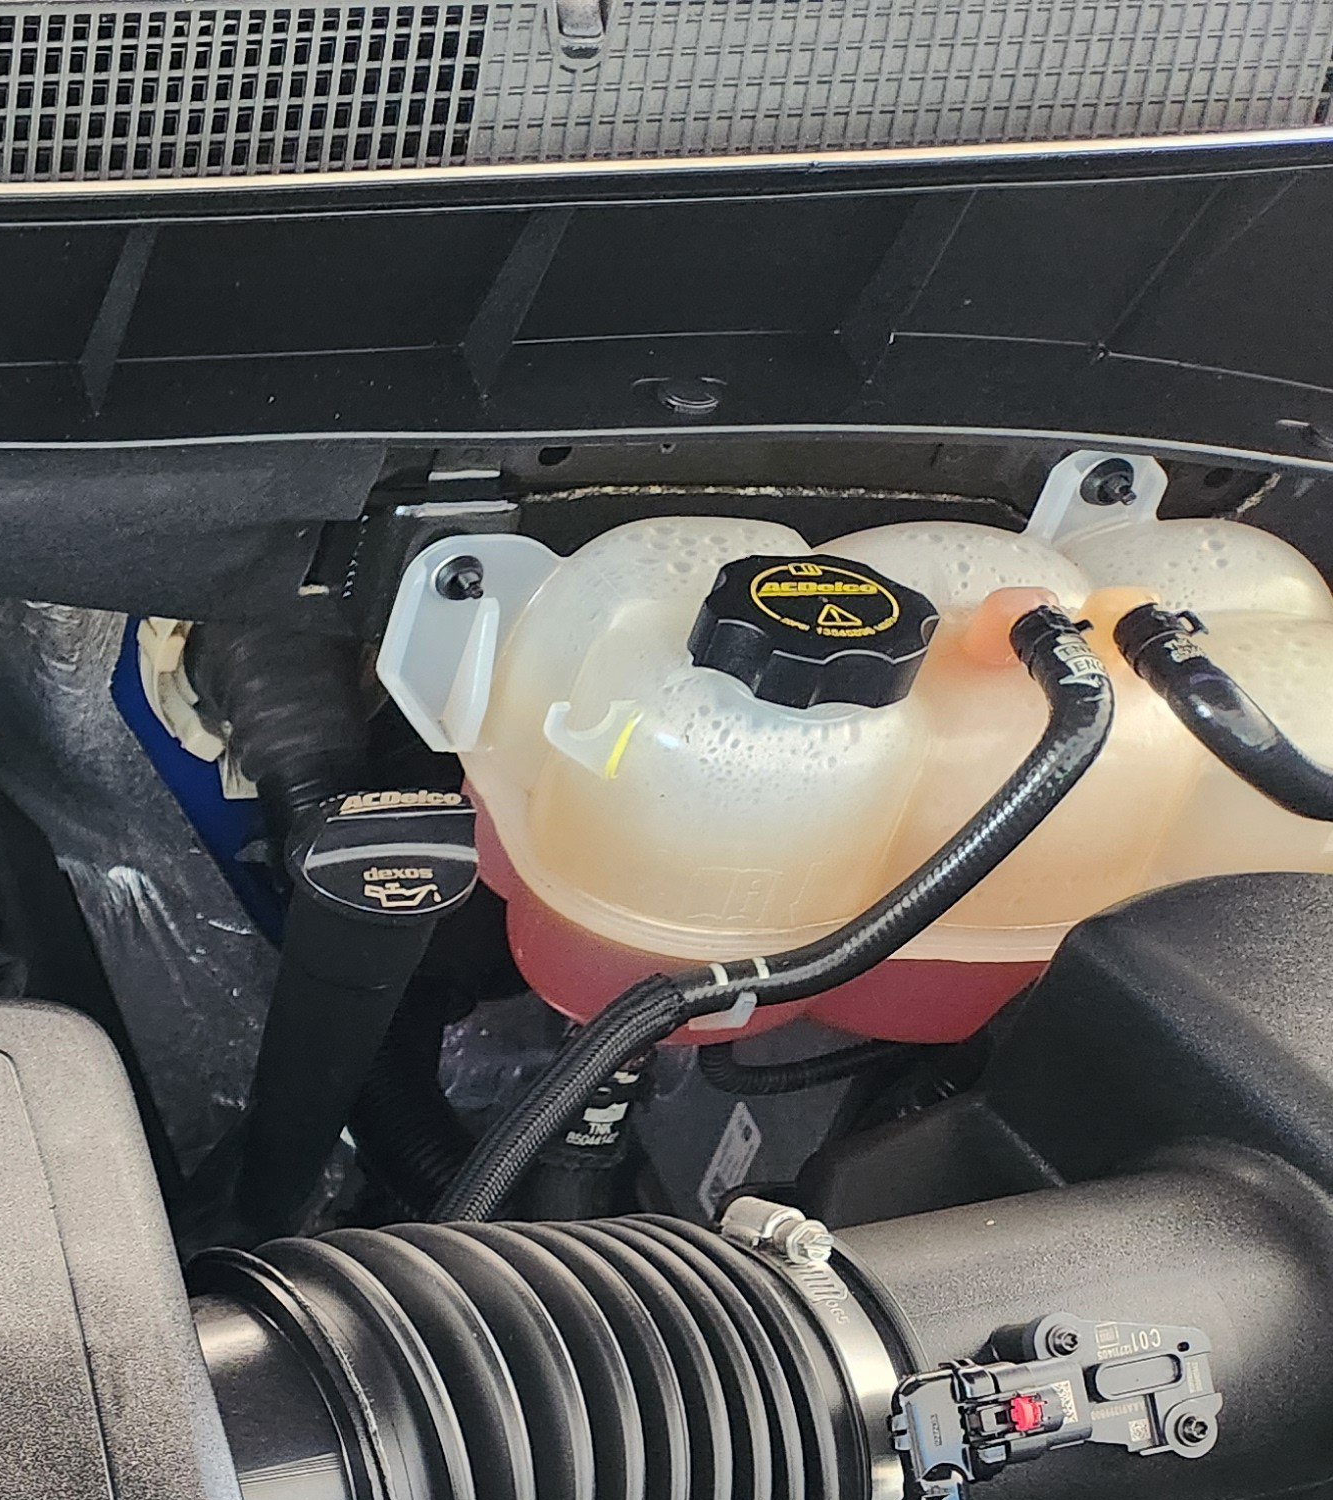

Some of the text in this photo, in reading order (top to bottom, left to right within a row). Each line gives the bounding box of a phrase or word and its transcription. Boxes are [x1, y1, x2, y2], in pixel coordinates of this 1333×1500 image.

[758, 581, 879, 597] ACDelco
[339, 790, 462, 815] ACDelco
[363, 867, 434, 882] dexos
[1130, 1328, 1162, 1352] C01
